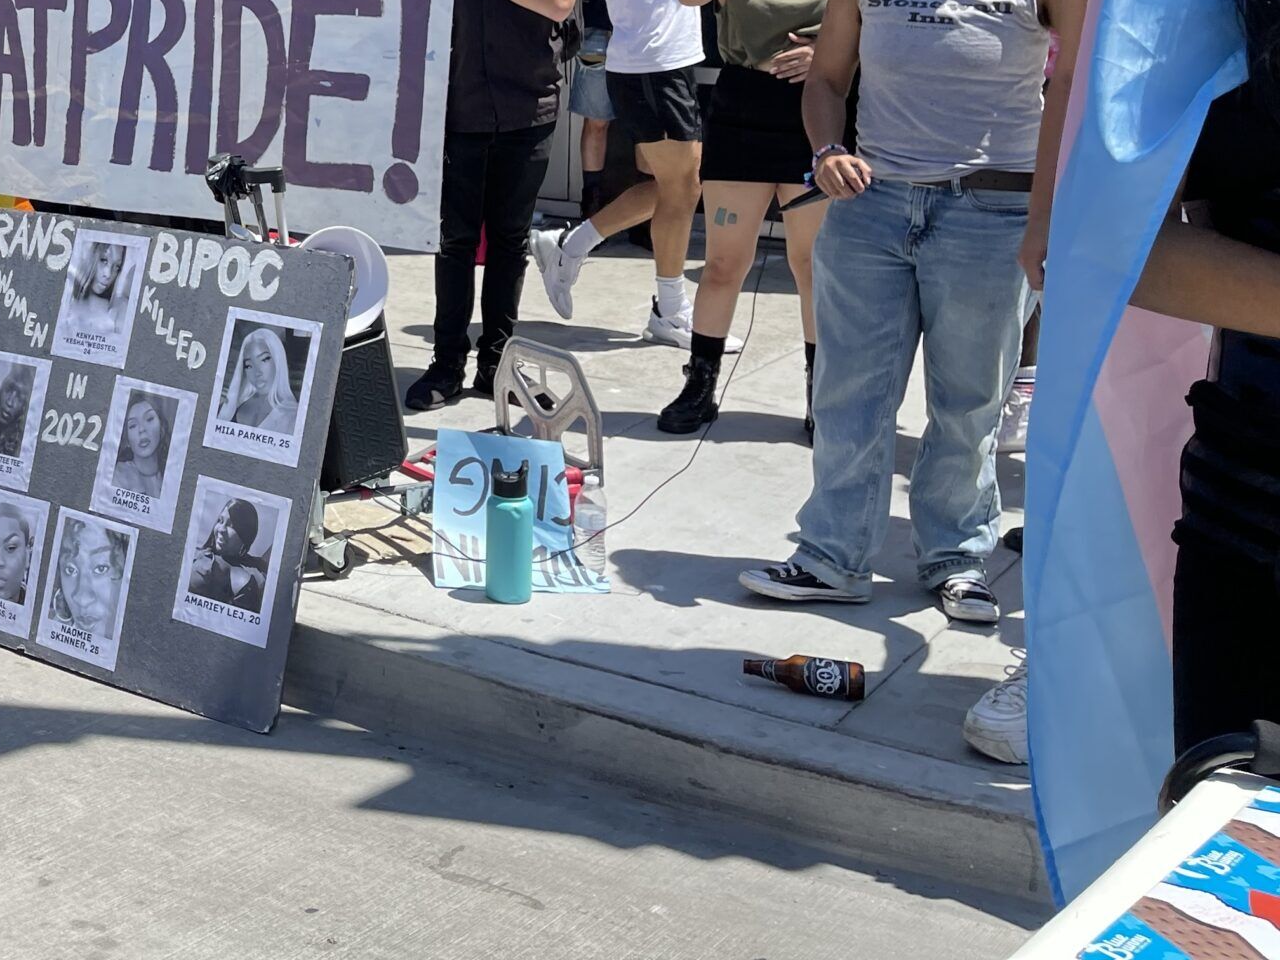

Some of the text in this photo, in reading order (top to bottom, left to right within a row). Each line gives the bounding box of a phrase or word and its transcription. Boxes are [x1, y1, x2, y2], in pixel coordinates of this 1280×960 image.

[907, 11, 955, 25] Inn
[147, 231, 285, 302] BIPOC
[140, 285, 207, 370] KILLED
[66, 372, 89, 400] IN
[40, 408, 104, 452] 2022
[237, 429, 277, 447] PARKER,
[279, 439, 291, 449] 25
[112, 496, 150, 514] RAMOS, 21
[115, 488, 150, 505] CYPRESS
[8, 612, 16, 621] 24
[184, 595, 261, 625] AMARIEY LEJ, 20
[50, 630, 88, 652] SKINNER,
[61, 625, 92, 642] NAOMIE
